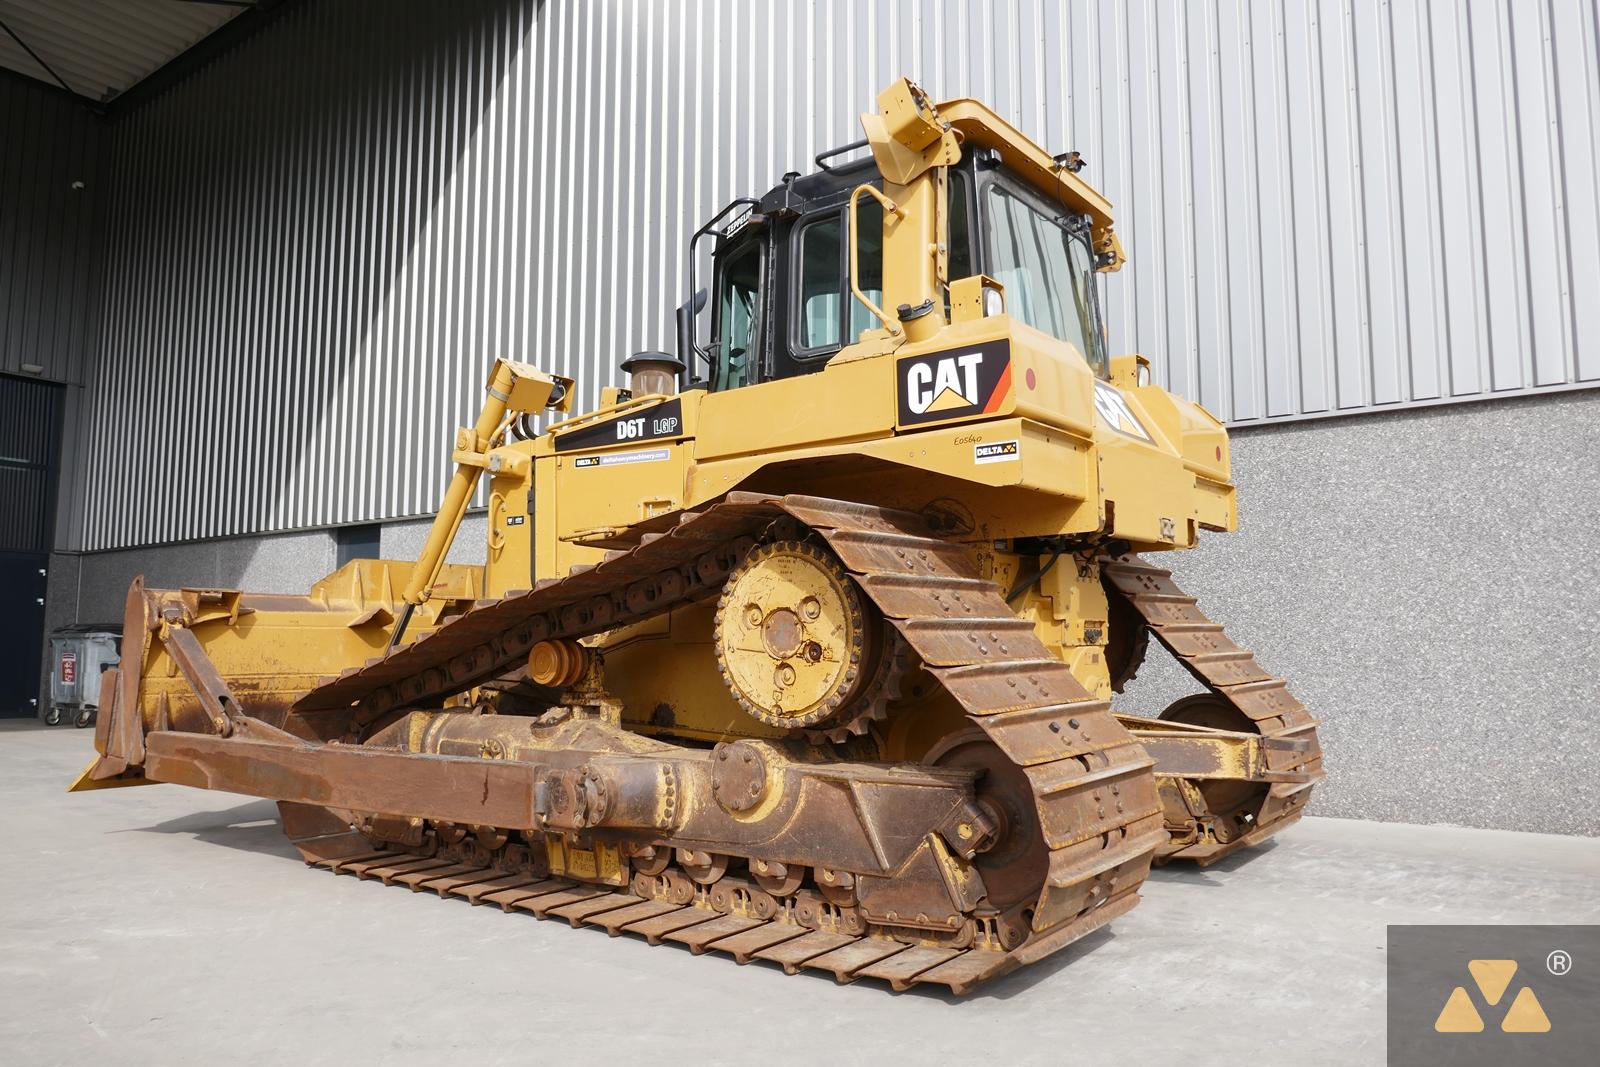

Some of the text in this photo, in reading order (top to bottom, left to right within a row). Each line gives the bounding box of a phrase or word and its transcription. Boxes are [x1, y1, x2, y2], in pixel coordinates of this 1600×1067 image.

[907, 352, 983, 415] CAT
[616, 417, 678, 440] D6T LGP
[977, 446, 1003, 456] DELTA
